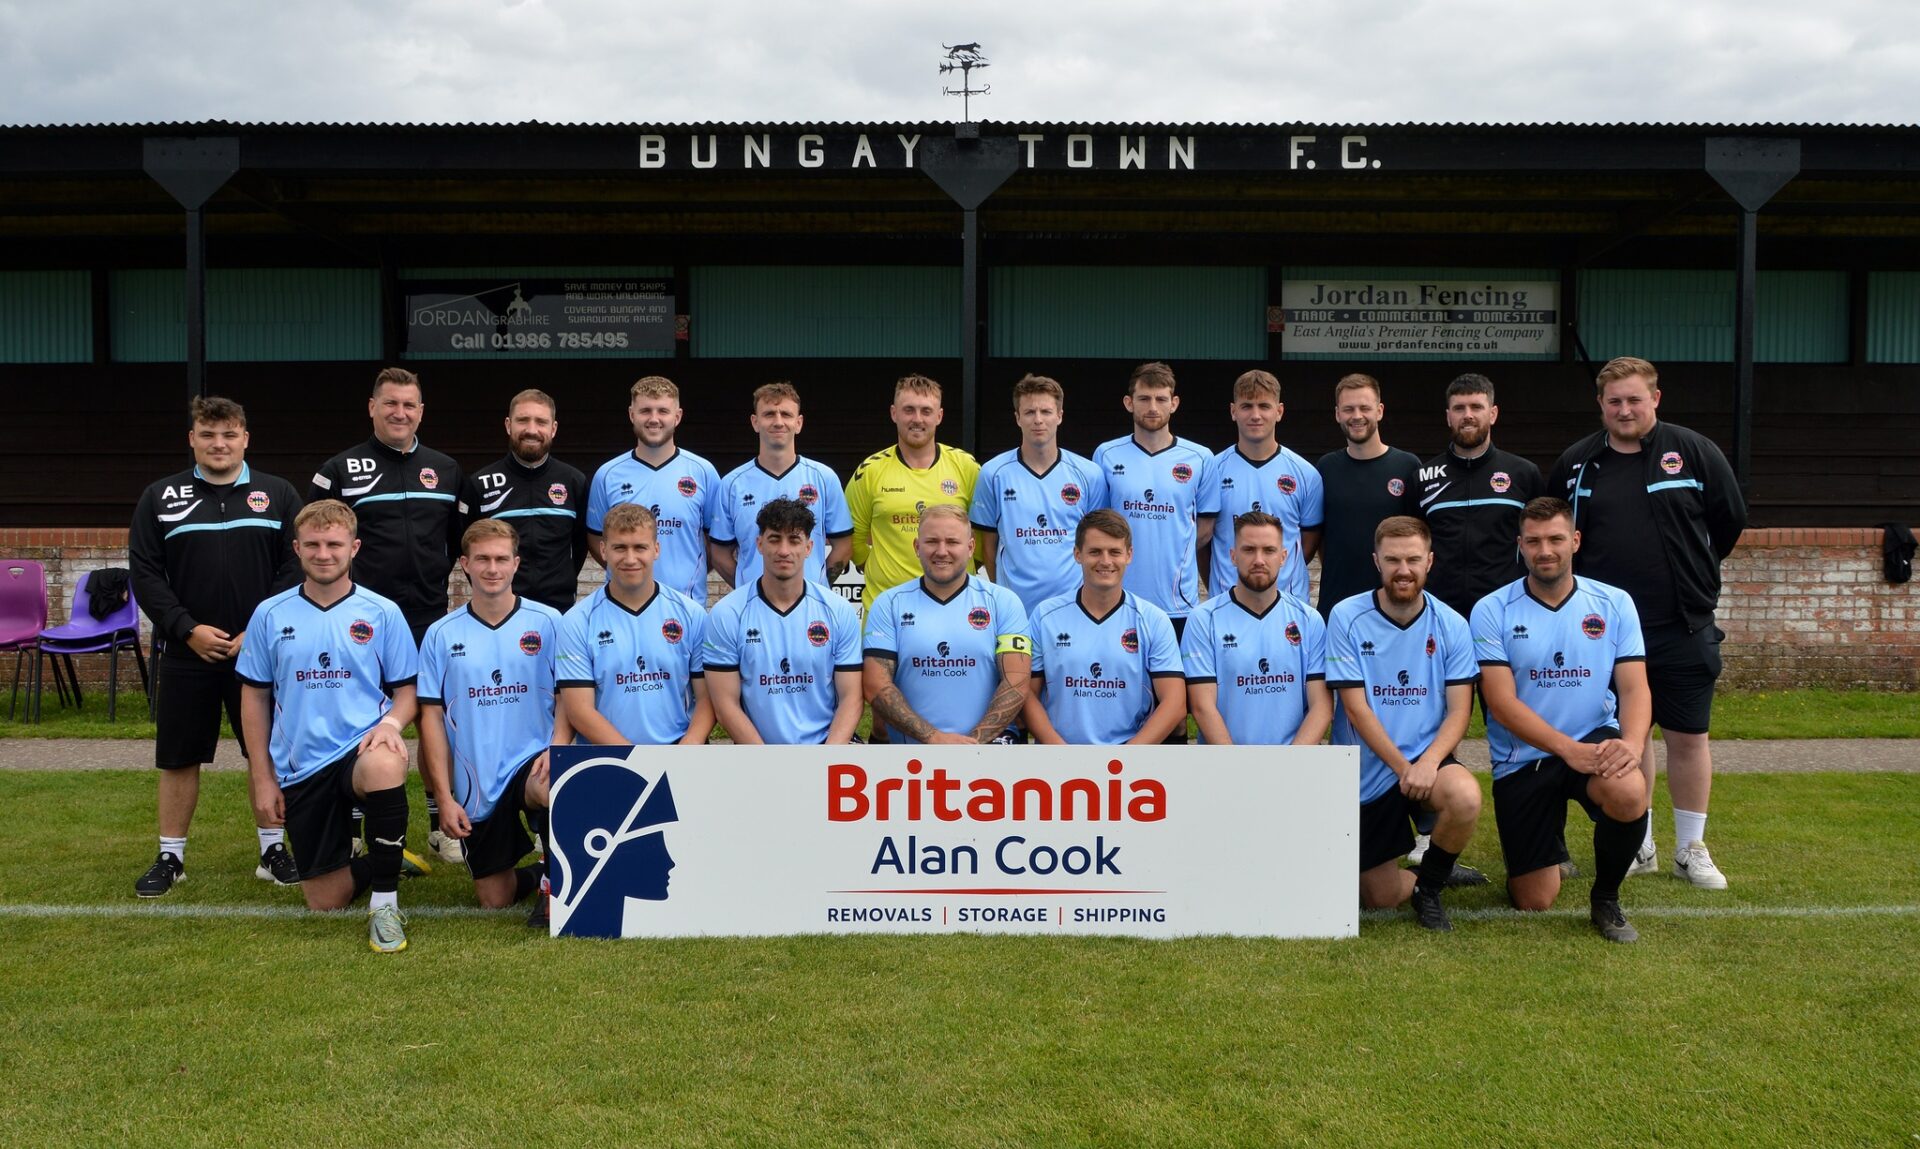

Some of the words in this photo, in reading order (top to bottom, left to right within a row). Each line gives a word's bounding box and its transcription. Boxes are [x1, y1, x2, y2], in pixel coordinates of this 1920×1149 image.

[639, 134, 921, 169] BUNGAY
[1018, 134, 1196, 170] TOWN
[564, 282, 590, 291] SAVE
[590, 282, 622, 291] MONEY
[625, 282, 638, 291] ON
[640, 282, 667, 291] SKIPS
[565, 292, 585, 300] AND
[587, 292, 613, 300] WORK
[615, 292, 665, 300] UNLOADING
[1310, 284, 1408, 305] Jordan
[1419, 284, 1528, 309] Fencing
[564, 306, 607, 314] COVERING
[610, 306, 646, 314] BUNGAY
[649, 306, 667, 314] AND
[1294, 311, 1335, 321] TRADE
[1359, 311, 1451, 322] COMMERCIAL
[1473, 311, 1545, 323] DOMESTIC
[409, 310, 490, 326] JORDAN
[568, 316, 628, 324] SURROUNDING
[633, 316, 663, 324] AREAS
[451, 332, 485, 349] Call
[491, 332, 552, 349] 01986
[557, 331, 629, 349] 785495
[1293, 325, 1320, 337] East
[1324, 325, 1375, 340] Anglia's
[1378, 326, 1428, 338] Premier
[1431, 326, 1481, 340] Fencing
[1484, 326, 1545, 342] Company
[346, 458, 377, 473] BD
[1419, 464, 1448, 482] MK
[478, 472, 507, 489] TD
[161, 485, 194, 500] AE
[1123, 499, 1175, 514] Britannia
[1129, 511, 1146, 519] Alan
[1147, 513, 1167, 521] Cook
[1015, 527, 1068, 538] Britannia
[1024, 538, 1042, 546] Alan
[1012, 636, 1025, 650] C
[912, 655, 976, 668] Britannia
[616, 669, 671, 685] Britannia
[759, 672, 813, 686] Britannia
[921, 668, 940, 677] Alan
[943, 668, 967, 677] Cook
[1237, 671, 1294, 687] Britannia
[1529, 665, 1591, 681] Britannia
[641, 683, 664, 692] Cook
[785, 685, 807, 694] Cook
[1065, 676, 1126, 689] Britannia
[1536, 680, 1556, 689] Alan
[1558, 679, 1582, 688] Cook
[468, 682, 528, 699] Britannia
[1073, 689, 1092, 698] Alan
[1094, 689, 1117, 698] Cook
[1245, 687, 1263, 695] Alan
[1264, 685, 1287, 694] Cook
[1373, 684, 1427, 697] Britannia
[477, 698, 498, 707] Alan
[828, 758, 1167, 822] Britannia
[871, 836, 978, 875] Alan
[995, 836, 1122, 875] Cook
[827, 907, 932, 922] REMOVALS
[958, 907, 1048, 922] STORAGE
[1073, 907, 1166, 923] SHIPPING
